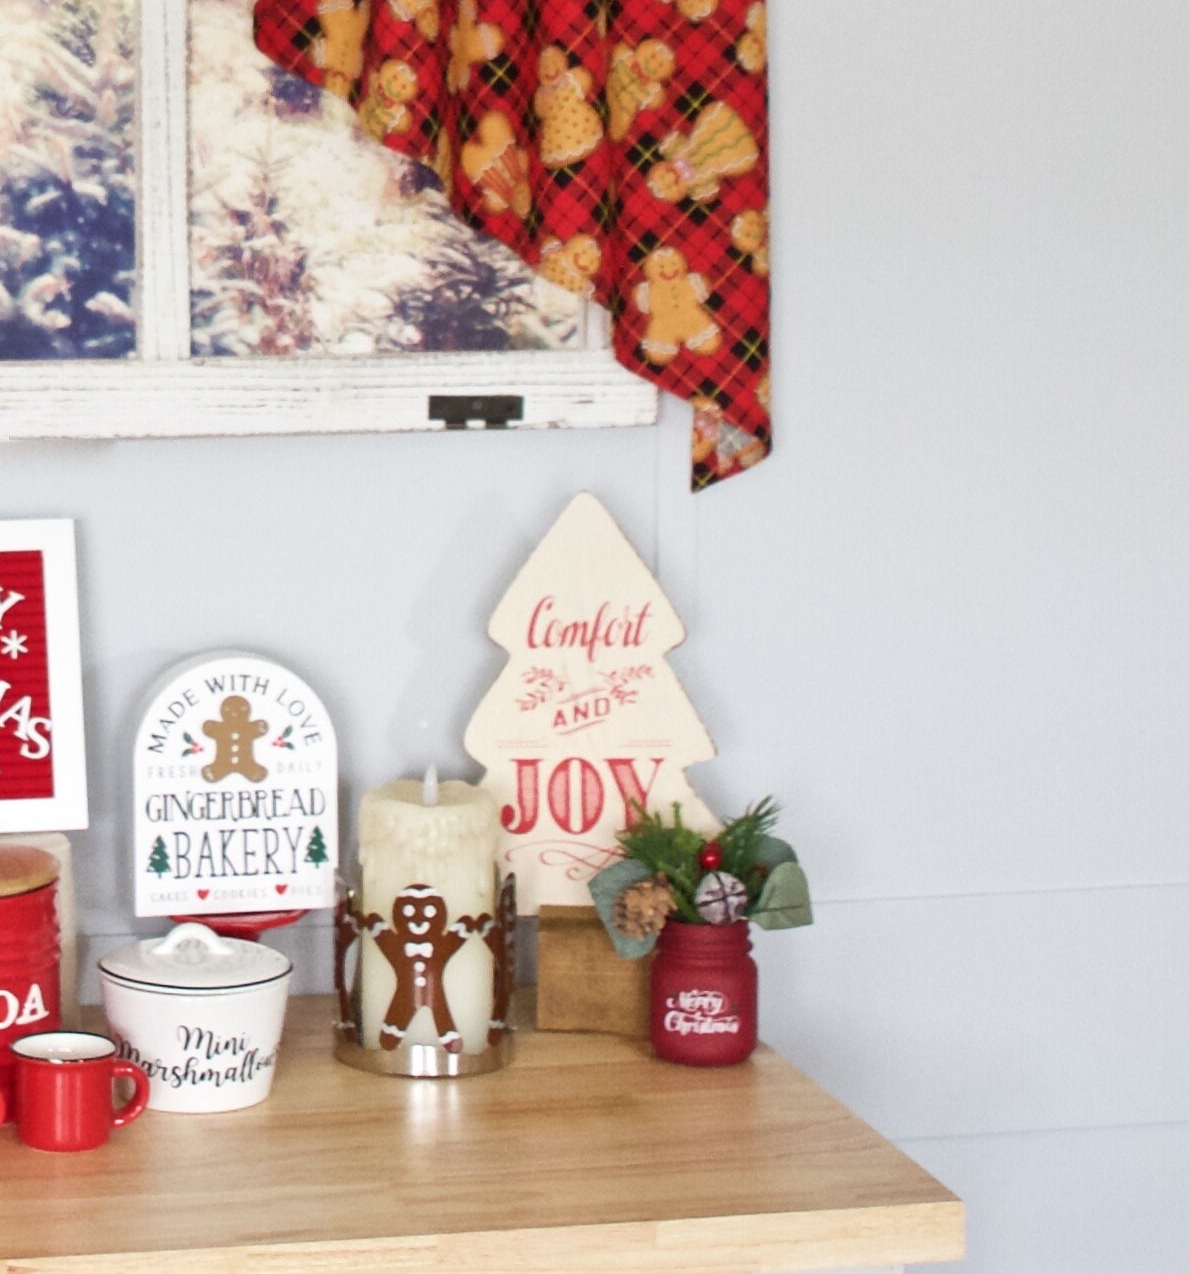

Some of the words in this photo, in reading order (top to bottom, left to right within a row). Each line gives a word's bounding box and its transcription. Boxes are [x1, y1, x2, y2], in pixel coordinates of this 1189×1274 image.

[527, 595, 651, 662] Comfort
[148, 689, 200, 754] MADE
[205, 674, 270, 696] WITH
[276, 688, 323, 747] LOVE
[552, 696, 611, 727] AND
[145, 788, 327, 823] GINGERBREAD
[500, 757, 666, 835] JOY
[173, 827, 305, 880] BAKERY
[178, 1025, 246, 1060] Mini
